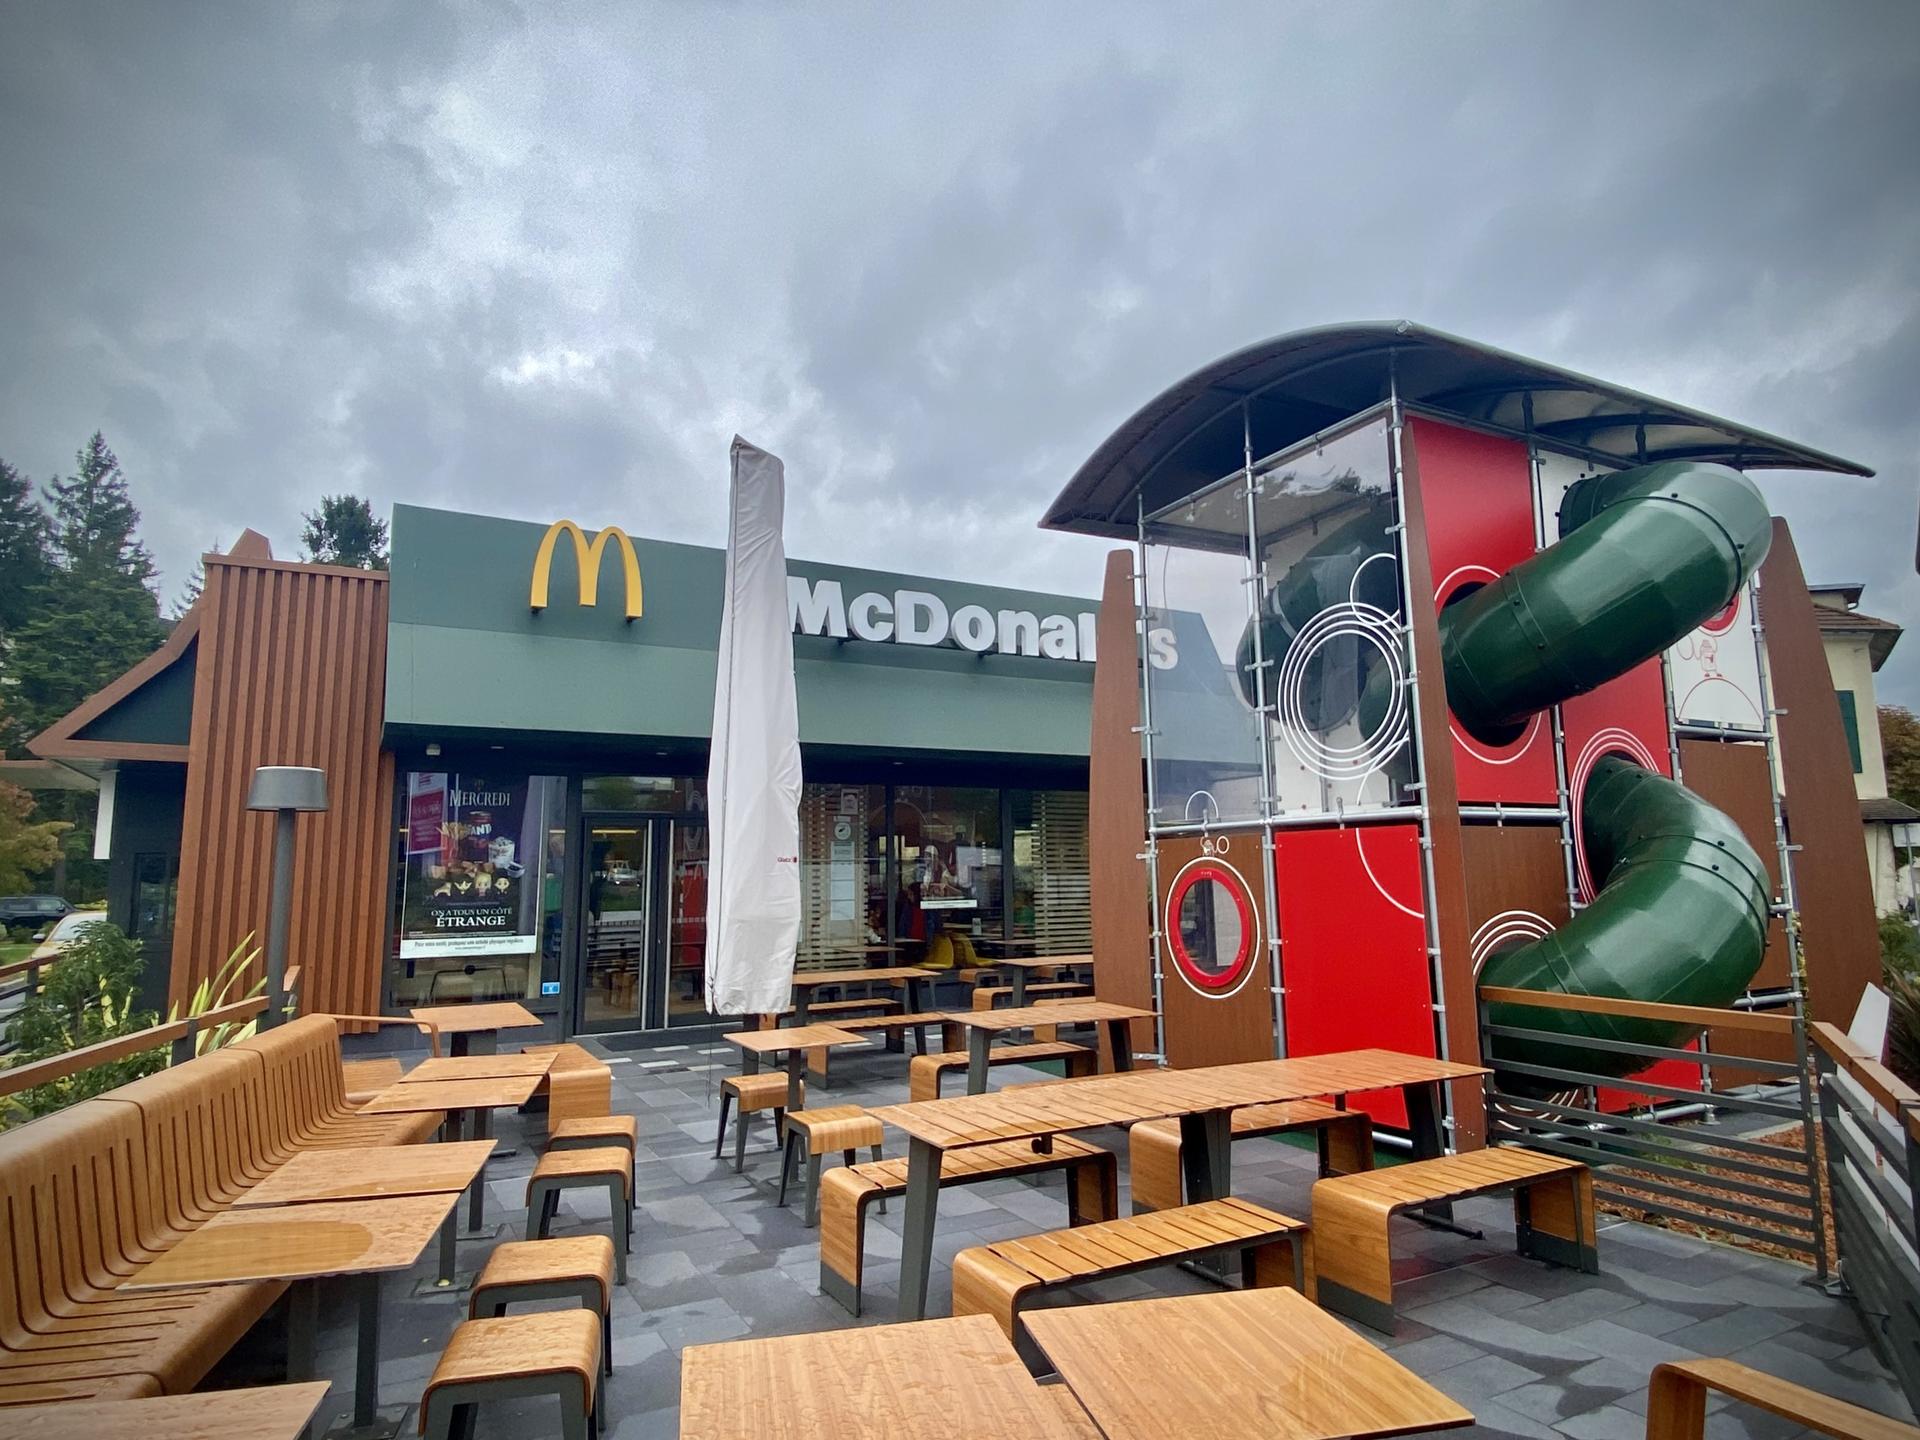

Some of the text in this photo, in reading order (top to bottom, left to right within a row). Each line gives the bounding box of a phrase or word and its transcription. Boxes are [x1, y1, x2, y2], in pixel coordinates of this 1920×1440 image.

[449, 789, 511, 807] MERCREDI
[452, 908, 475, 916] TOUS
[435, 914, 506, 927] ÉTRANGE
